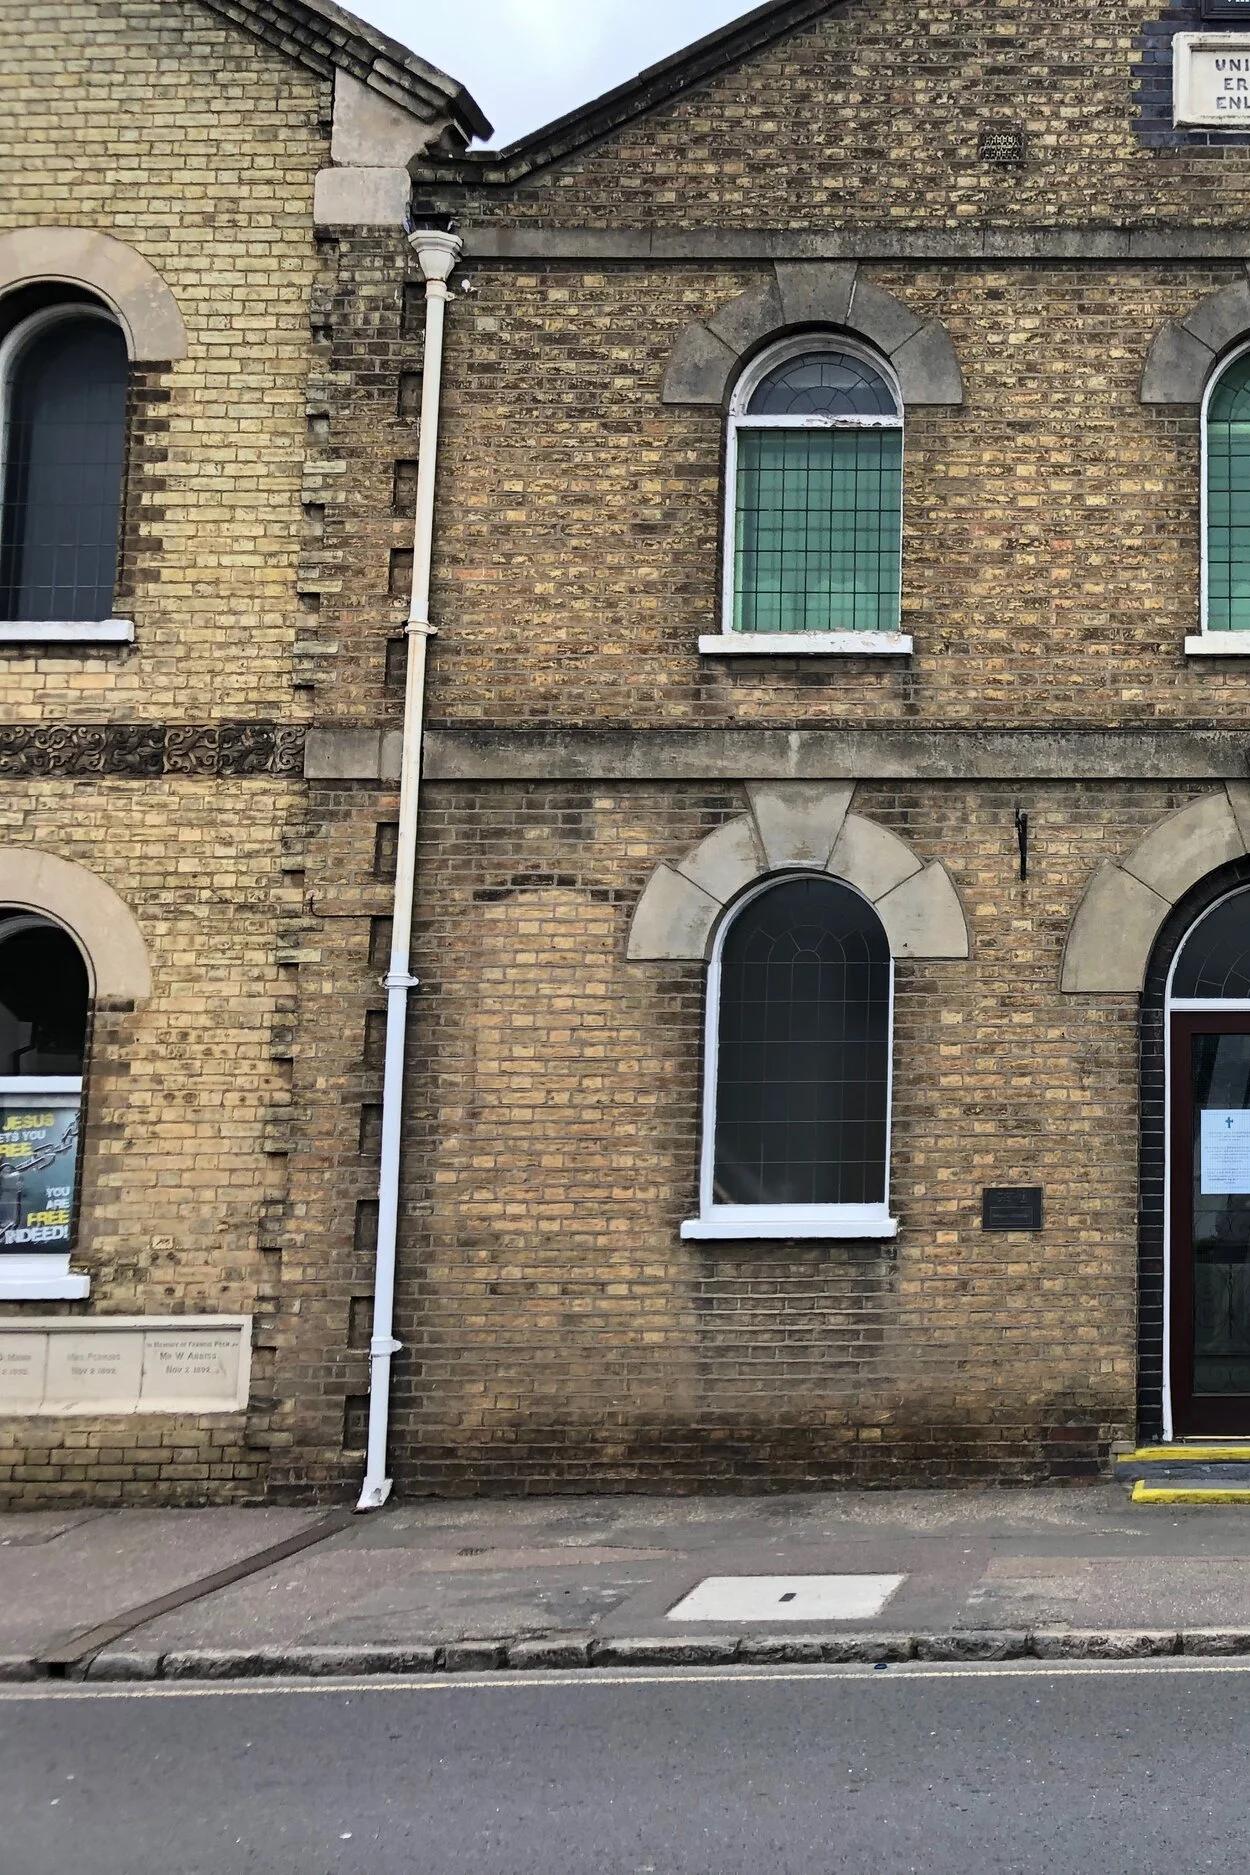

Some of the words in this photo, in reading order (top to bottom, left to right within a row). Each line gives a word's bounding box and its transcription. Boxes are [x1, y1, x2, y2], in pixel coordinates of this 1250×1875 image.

[2, 1113, 55, 1131] JESUS
[22, 1129, 47, 1141] YOU
[46, 1186, 71, 1199] YOU
[46, 1199, 70, 1210] ARE
[27, 1210, 70, 1227] FREE
[5, 1226, 70, 1245] INDEED!
